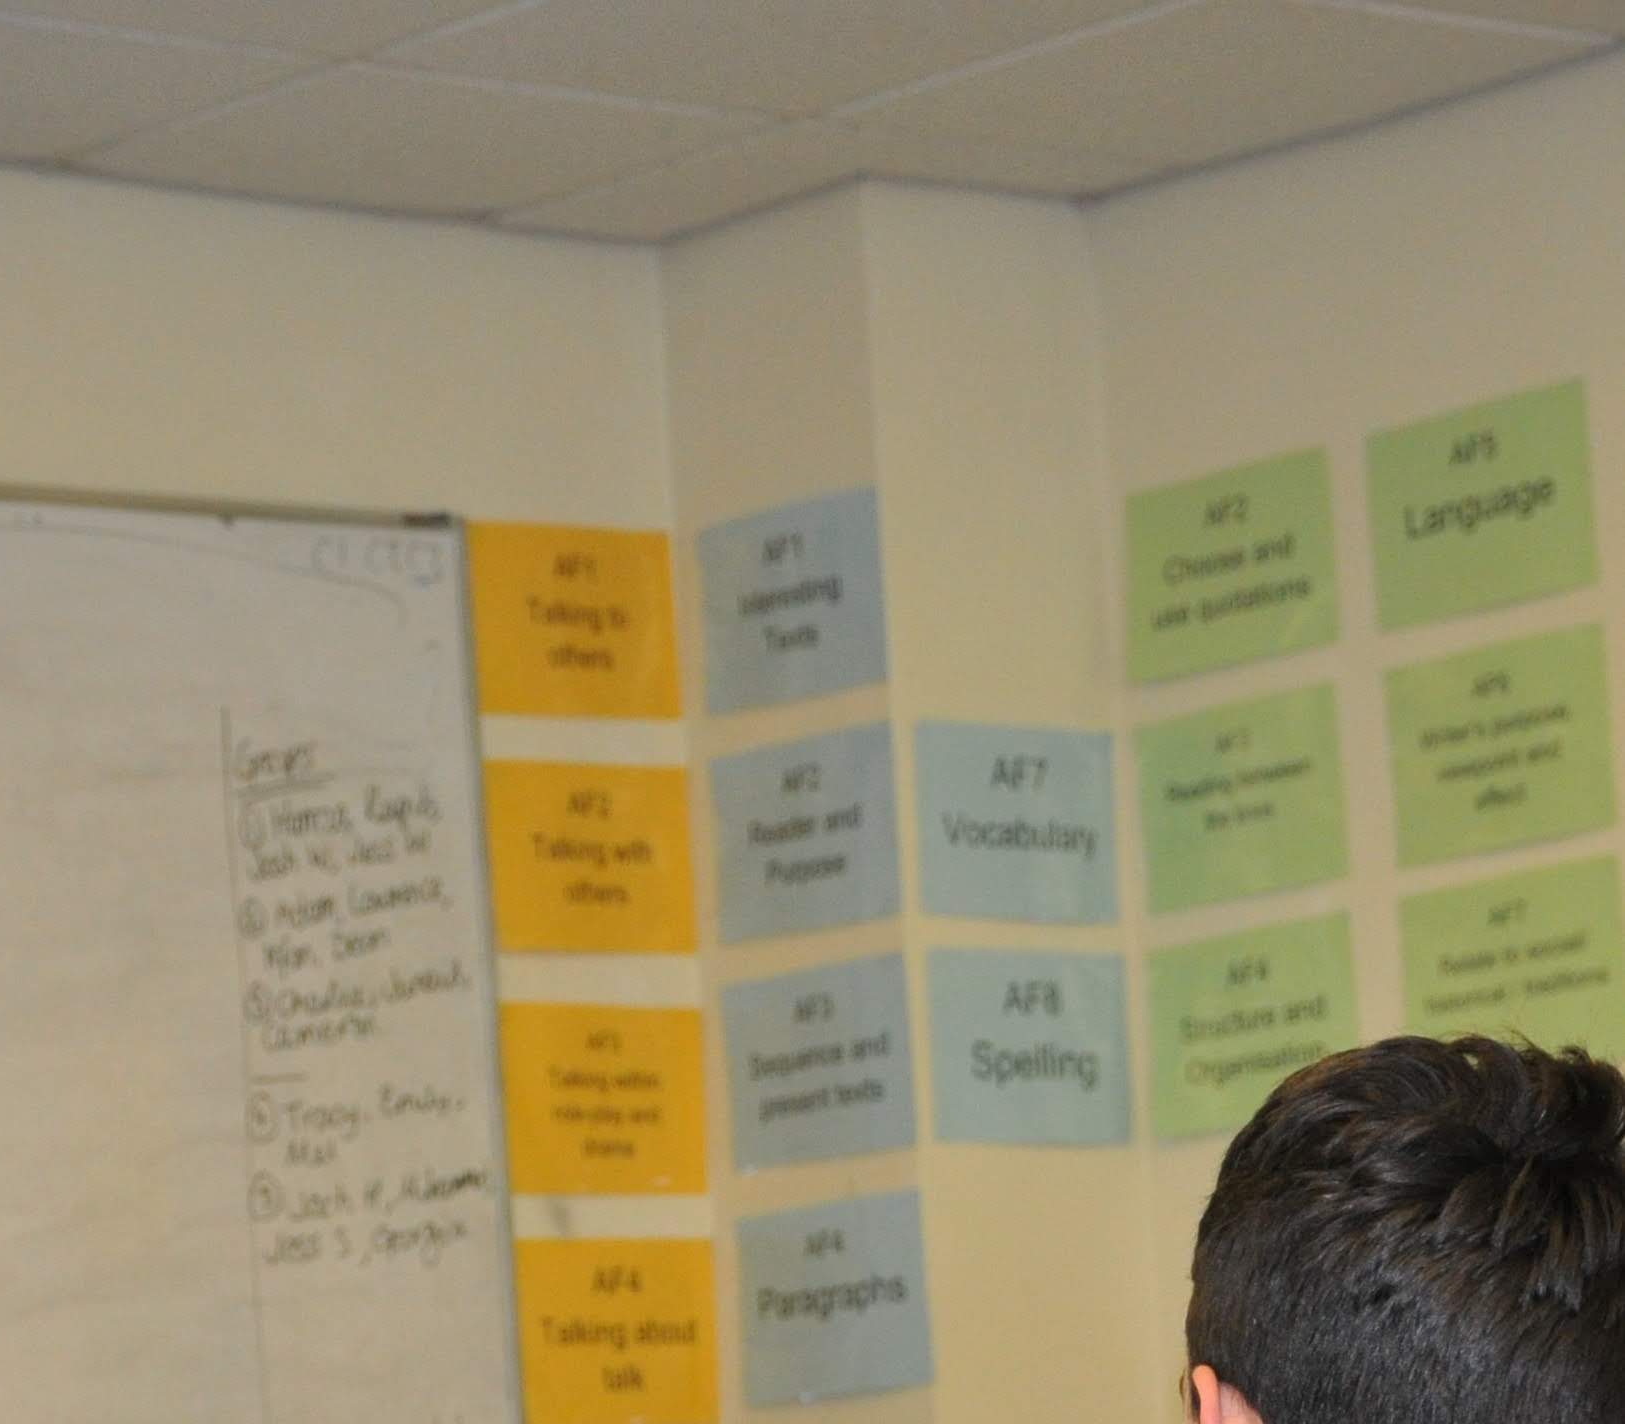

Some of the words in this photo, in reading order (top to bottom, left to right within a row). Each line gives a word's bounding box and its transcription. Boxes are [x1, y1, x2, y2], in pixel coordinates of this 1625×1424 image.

[1402, 474, 1558, 543] Language
[1252, 528, 1298, 565] and
[526, 595, 604, 636] Talking
[607, 603, 630, 630] to
[544, 644, 616, 672] others
[990, 753, 1050, 794] AF7
[823, 800, 865, 834] and
[941, 797, 1100, 862] Vocabulary
[528, 830, 608, 870] Talking
[611, 836, 654, 866] with
[562, 879, 633, 908] others
[1001, 978, 1064, 1019] AF8
[1281, 992, 1329, 1025] and
[849, 1028, 892, 1062] and
[971, 1040, 1101, 1091] Spelling
[590, 1264, 644, 1297] AF4
[755, 1272, 911, 1324] Paragraphs
[539, 1314, 629, 1353] Talking
[633, 1314, 699, 1347] about
[601, 1361, 646, 1394] talk
